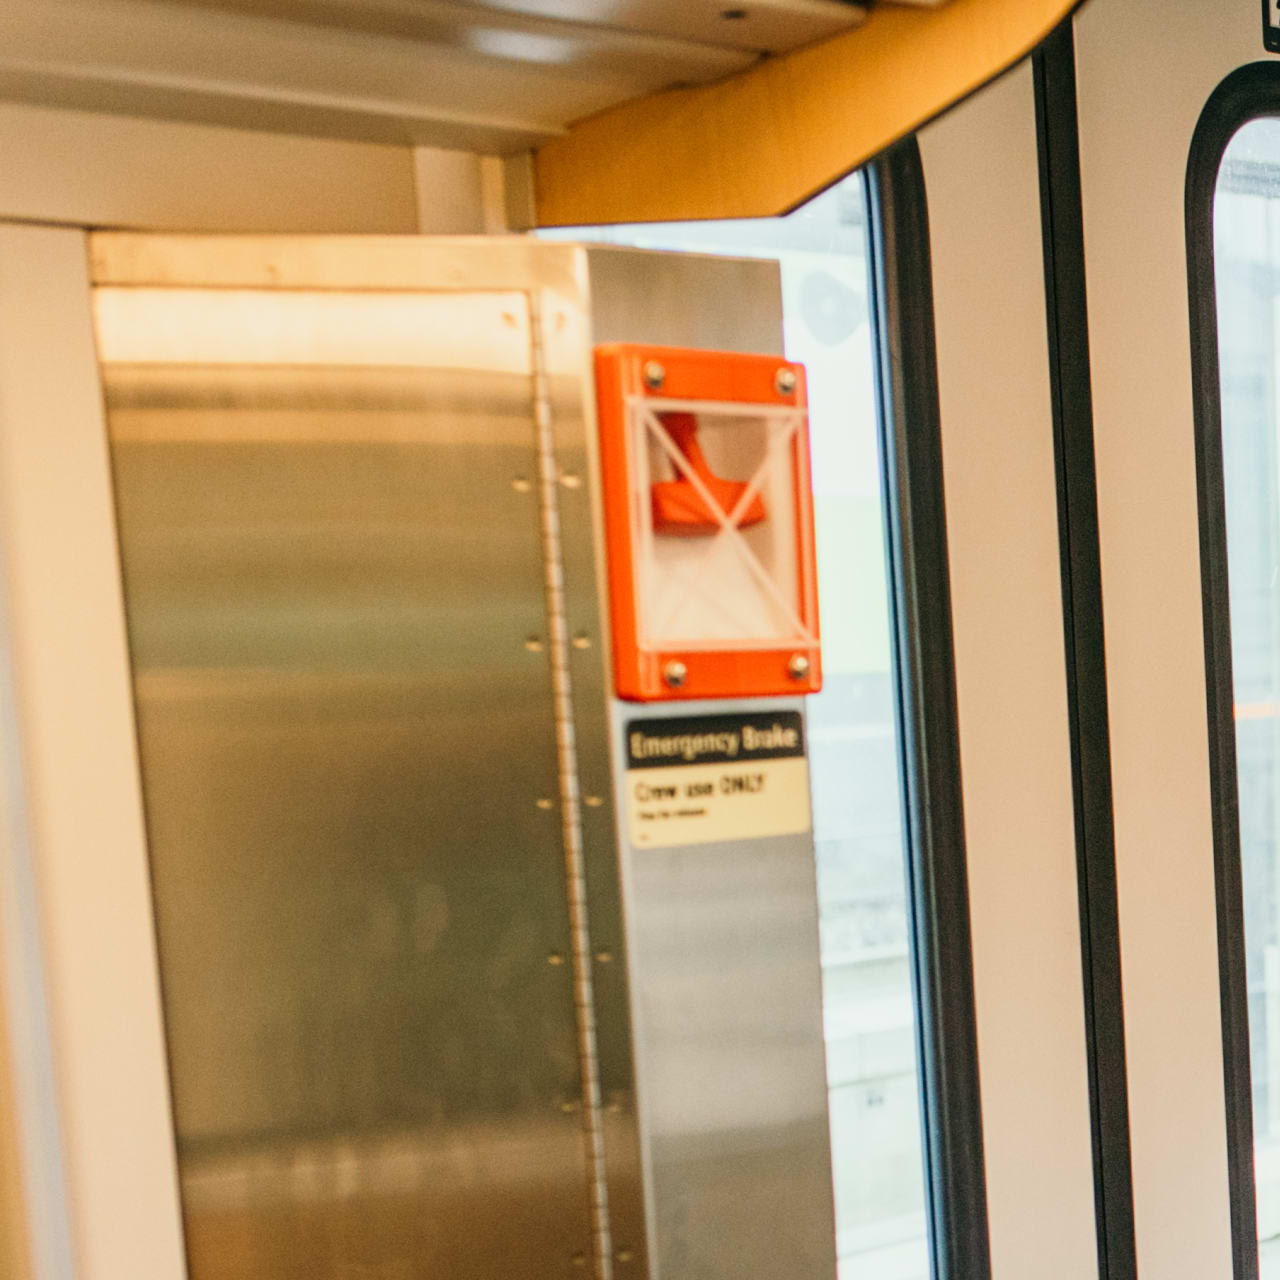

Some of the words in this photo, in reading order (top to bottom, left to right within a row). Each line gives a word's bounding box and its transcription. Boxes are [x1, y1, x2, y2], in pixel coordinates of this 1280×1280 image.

[630, 732, 740, 760] Emergency
[742, 723, 798, 750] Brake
[635, 780, 677, 803] Crew
[685, 782, 714, 798] use
[719, 774, 765, 795] ONLY
